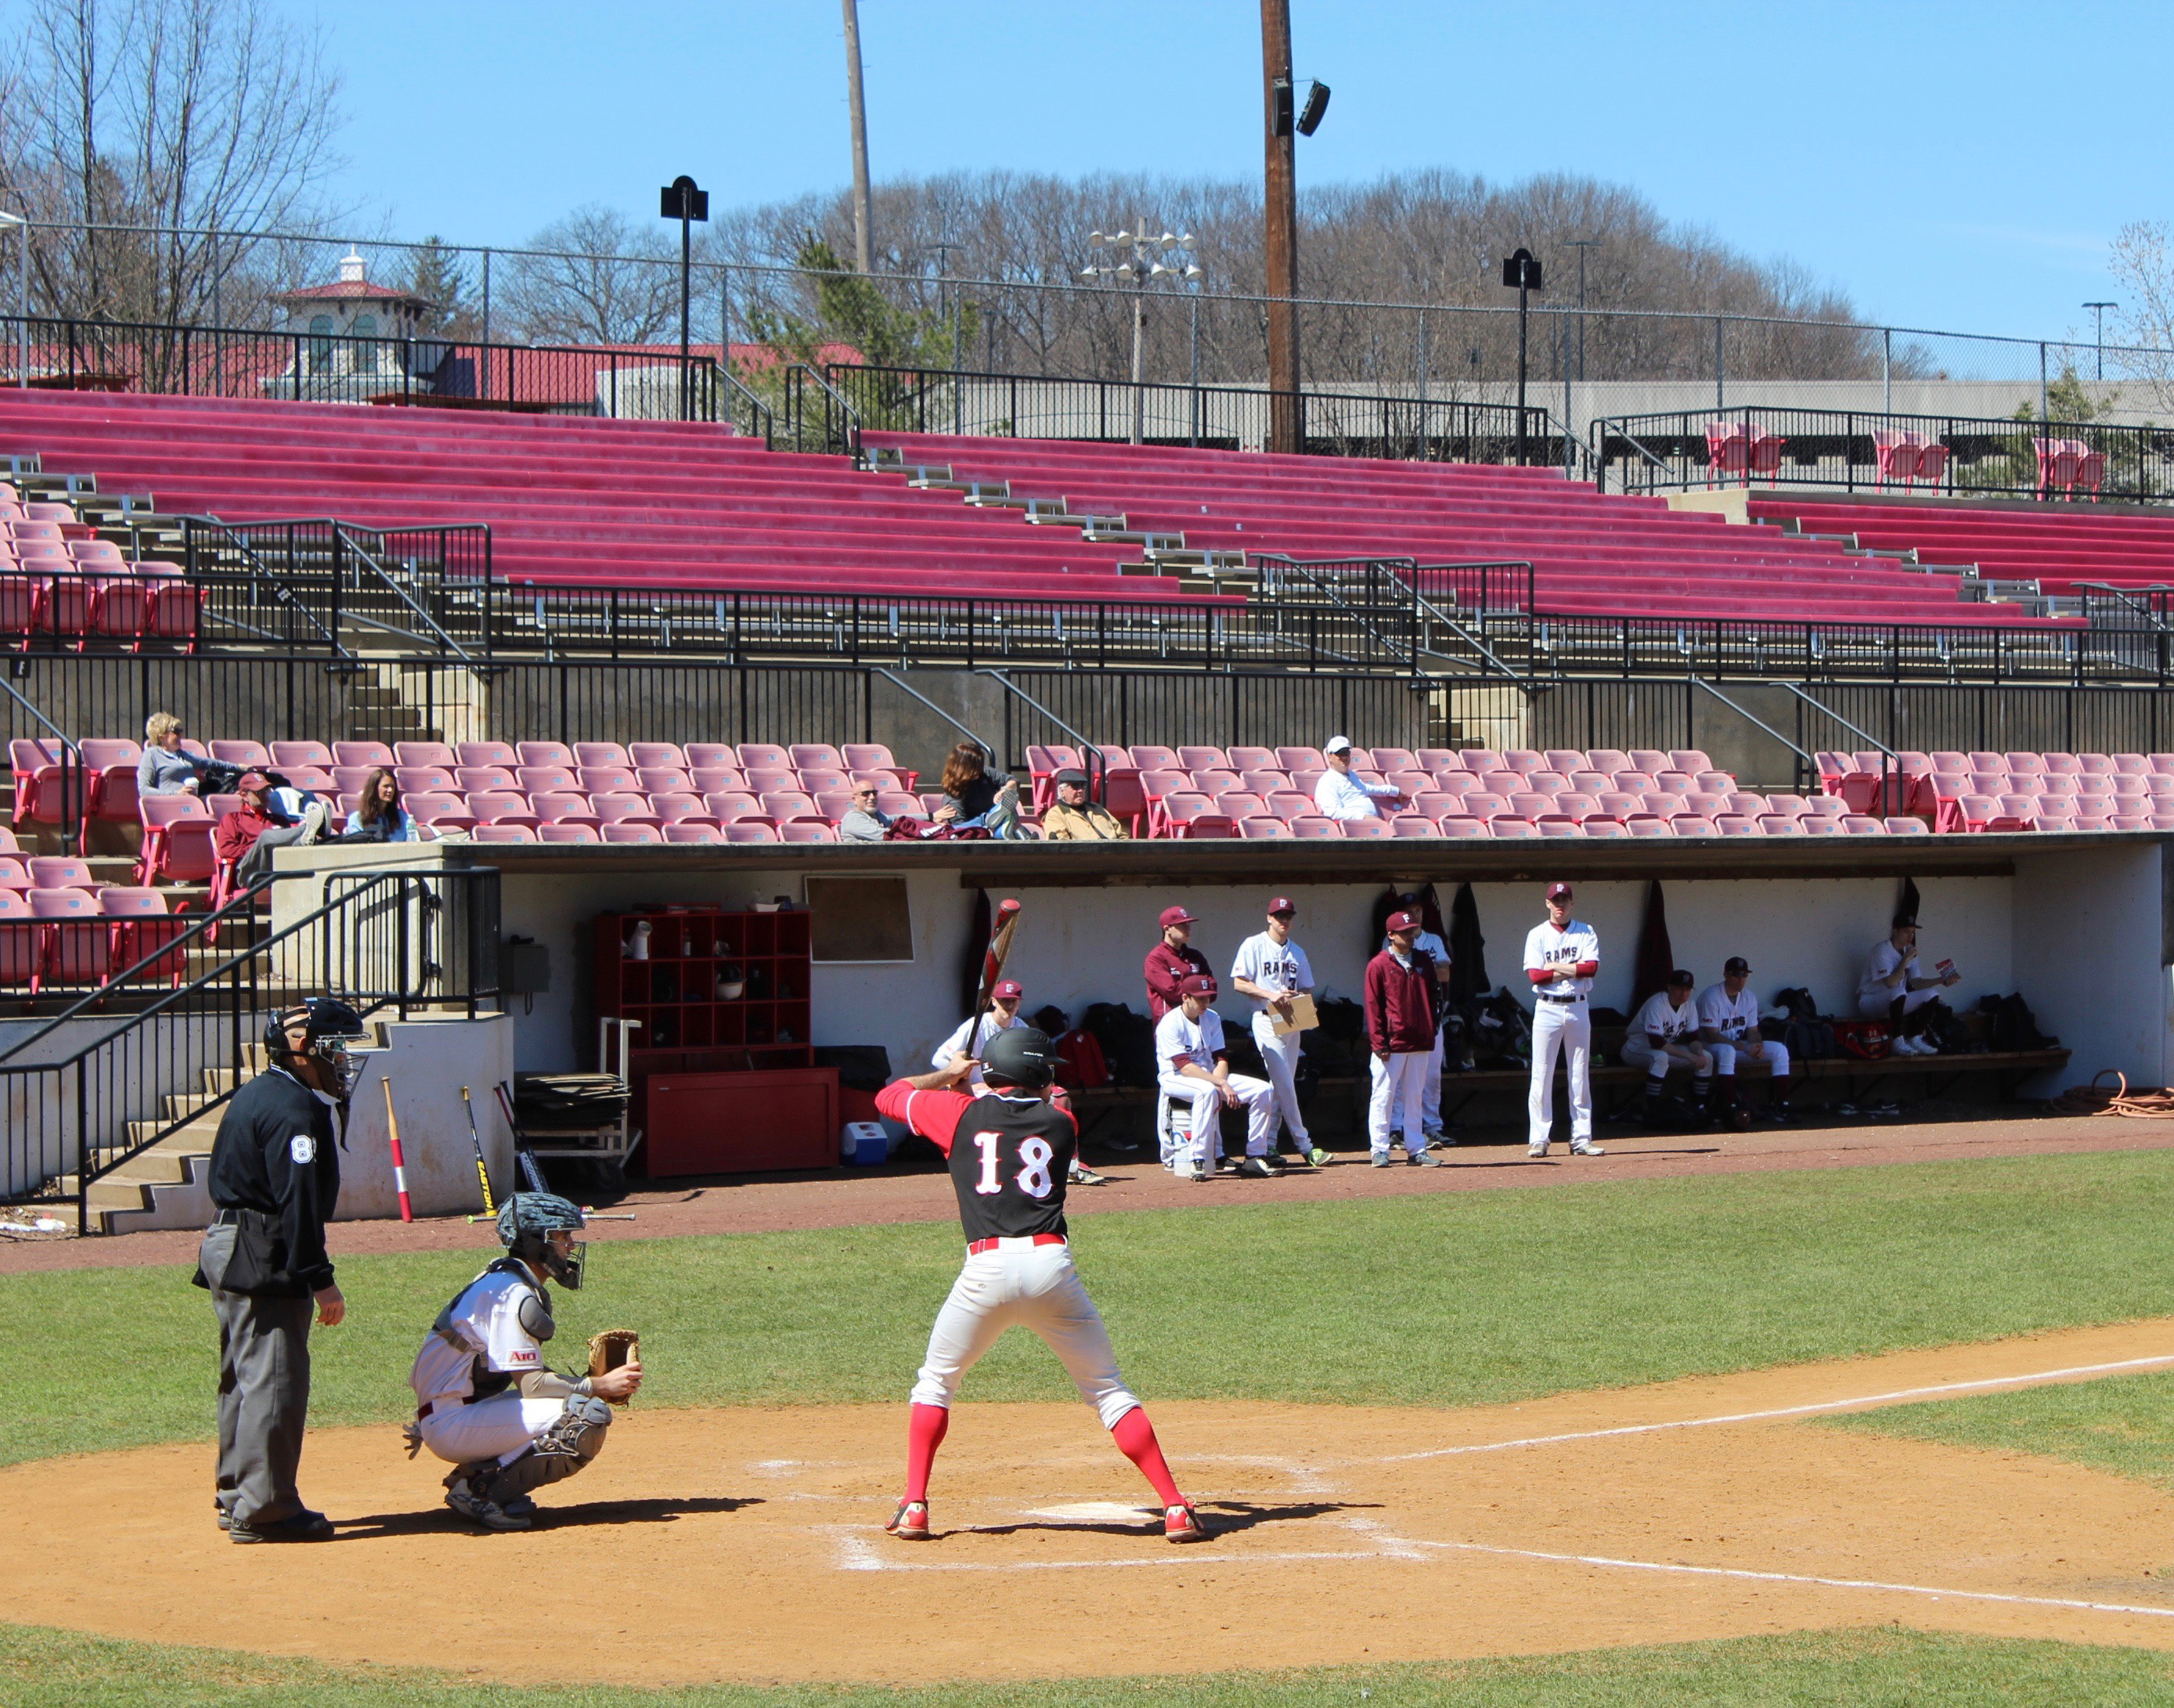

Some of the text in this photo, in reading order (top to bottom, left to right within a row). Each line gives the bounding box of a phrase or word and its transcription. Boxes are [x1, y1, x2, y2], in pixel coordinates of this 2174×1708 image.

[1402, 913, 1410, 924] F
[1545, 946, 1577, 963] RAMS
[1264, 961, 1297, 976] RAMS
[1288, 978, 1296, 990] 3
[291, 1135, 313, 1163] 8
[973, 1130, 1055, 1198] 18
[477, 1160, 495, 1209] EASTON
